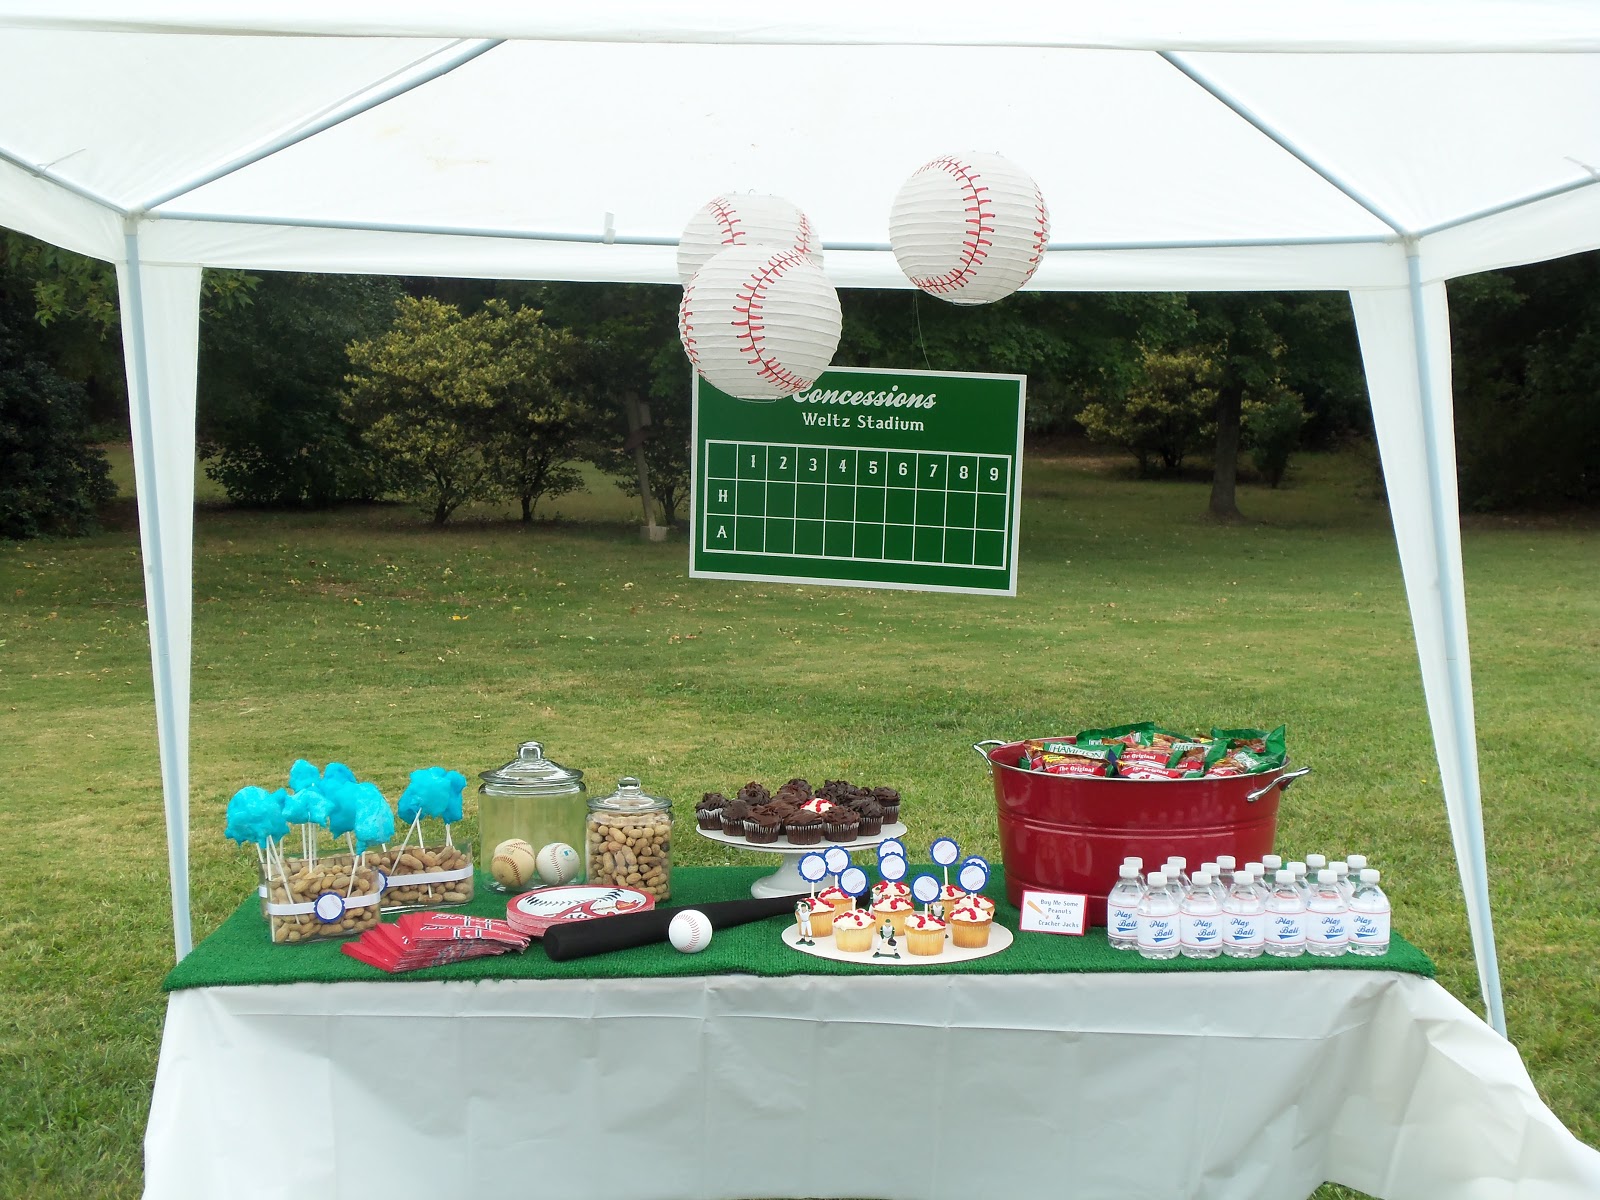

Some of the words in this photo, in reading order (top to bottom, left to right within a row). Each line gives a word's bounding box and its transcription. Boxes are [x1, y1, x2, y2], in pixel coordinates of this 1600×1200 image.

[792, 383, 936, 409] Concessions
[801, 412, 851, 428] Weltz
[857, 414, 925, 431] Stadium
[750, 454, 756, 469] 1
[779, 456, 788, 470] 2
[808, 458, 818, 472] 3
[838, 459, 847, 473] 4
[868, 461, 879, 475] 5
[898, 462, 908, 476] 6
[929, 464, 938, 478] 7
[959, 465, 969, 480] 8
[989, 467, 999, 481] 9
[718, 489, 728, 503] H
[716, 525, 728, 539] A
[1040, 898, 1051, 907] Buy
[1114, 910, 1132, 920] Play
[1354, 915, 1373, 924] Play
[1118, 919, 1138, 928] Ball
[1149, 920, 1169, 929] Play
[1193, 919, 1213, 928] Play
[1230, 918, 1250, 928] Play
[1275, 917, 1295, 926] Play
[1321, 916, 1341, 926] Play
[1154, 929, 1174, 938] Ball
[1197, 928, 1217, 937] Ball
[1234, 927, 1254, 936] Ball
[1280, 926, 1299, 935] Ball
[1326, 926, 1345, 935] Ball
[1357, 925, 1377, 934] Ball
